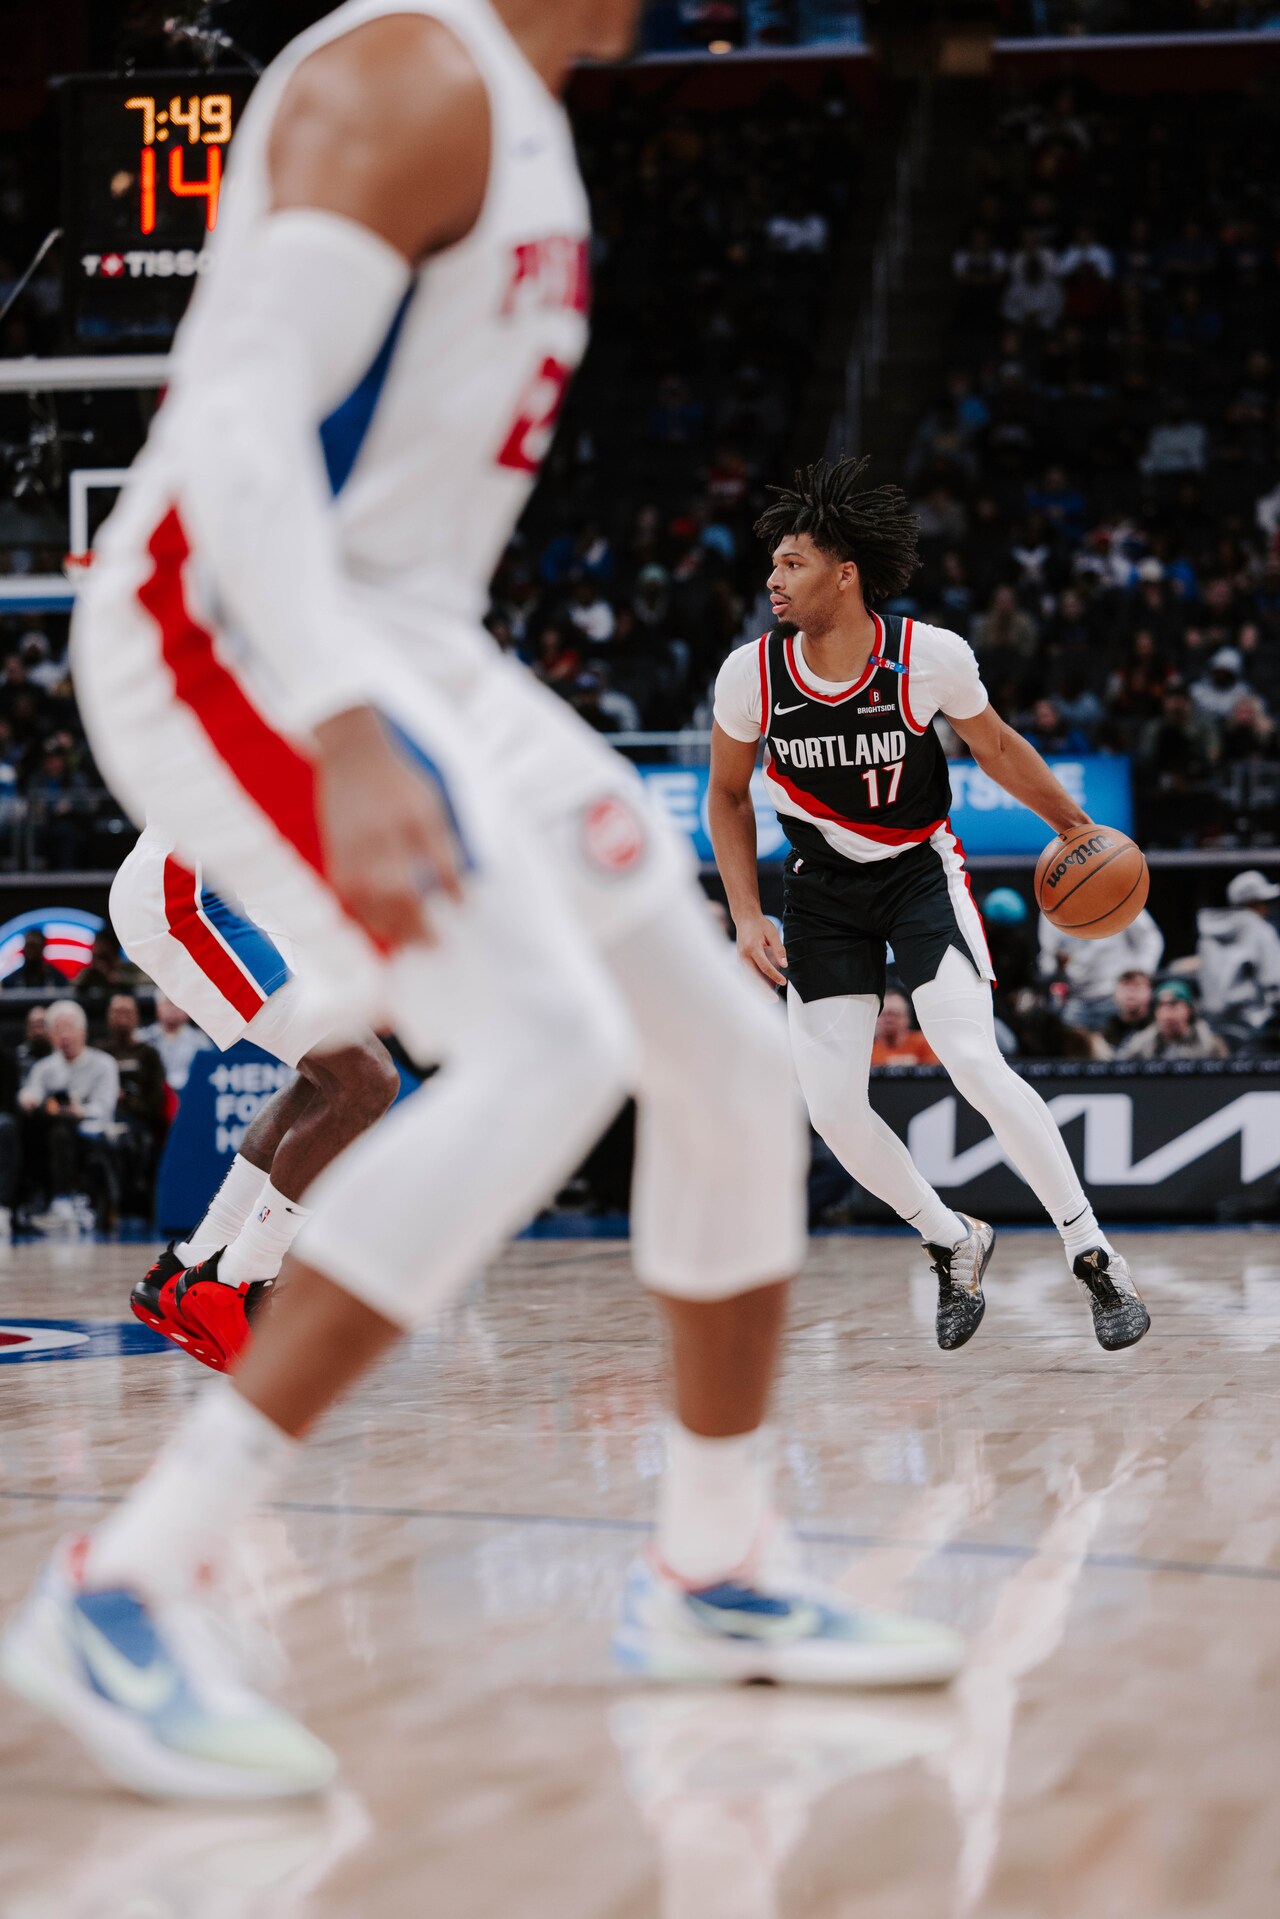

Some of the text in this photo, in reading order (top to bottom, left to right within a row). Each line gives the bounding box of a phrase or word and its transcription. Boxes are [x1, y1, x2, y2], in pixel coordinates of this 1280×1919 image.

[124, 94, 232, 145] 7:49
[141, 145, 222, 235] 14
[125, 250, 214, 278] TISSO
[857, 703, 896, 714] BRIGHTSIDE
[771, 730, 907, 769] PORTLAND
[861, 761, 904, 809] 17
[1046, 834, 1115, 888] Wilson
